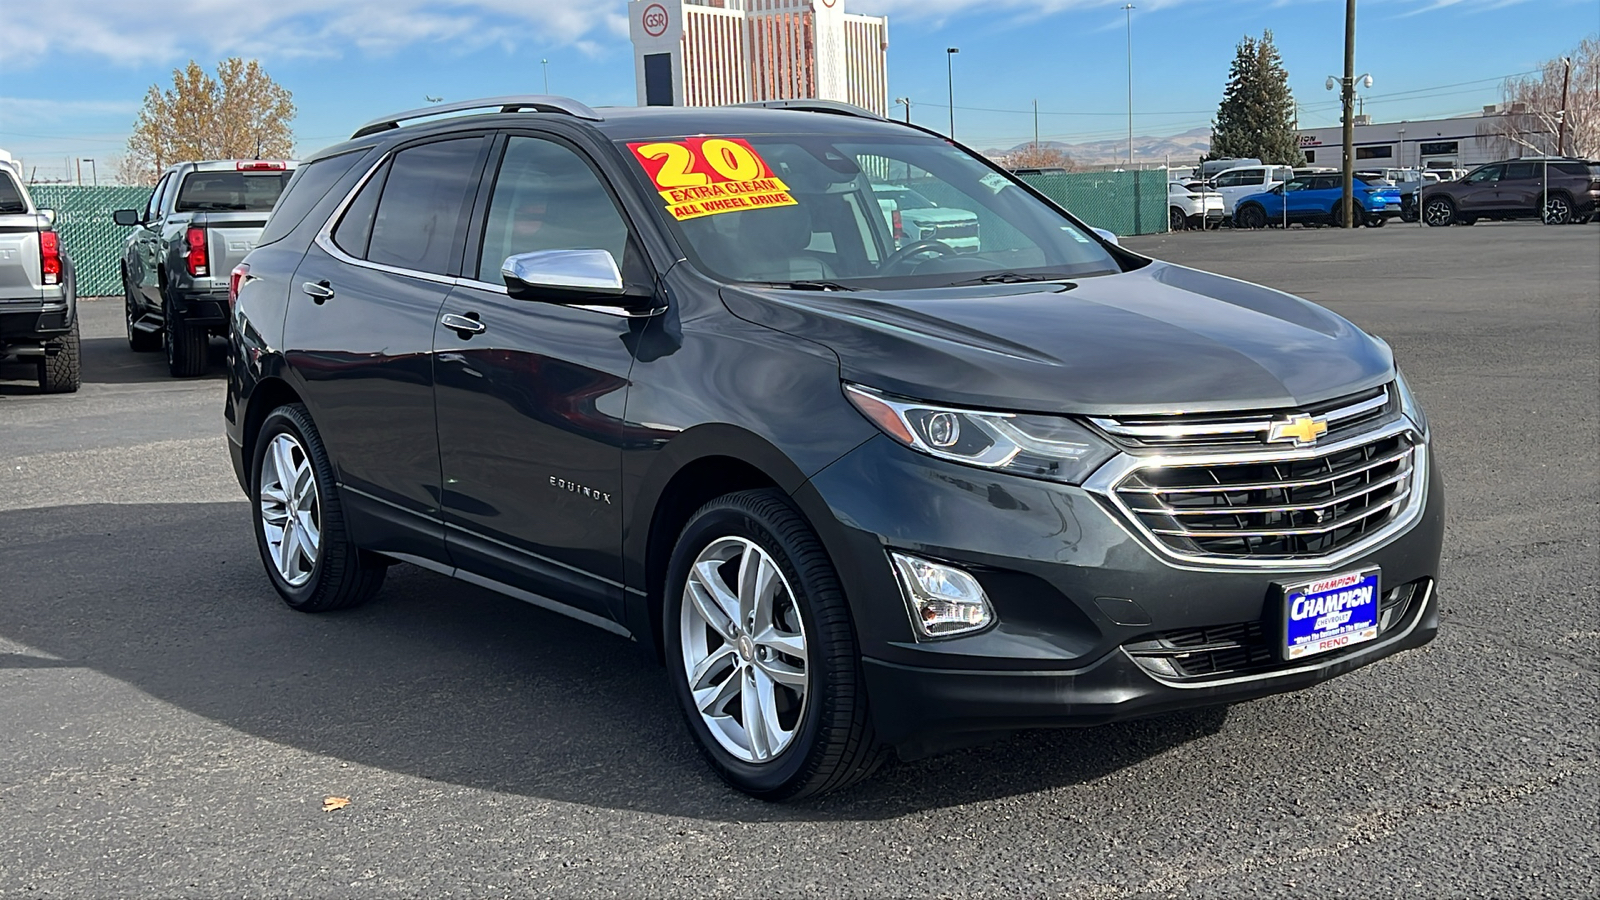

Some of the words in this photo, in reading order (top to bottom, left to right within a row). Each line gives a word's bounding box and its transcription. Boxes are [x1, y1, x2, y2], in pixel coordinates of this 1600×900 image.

[645, 13, 665, 28] GSR
[637, 139, 764, 188] 20
[670, 186, 726, 202] EXTRA
[725, 179, 778, 195] CLEAN
[674, 204, 703, 218] ALL
[701, 196, 749, 213] WHEEL
[751, 193, 791, 206] DRIVE
[549, 475, 611, 505] EQUINOX
[1312, 575, 1357, 592] CHAMPION
[1291, 586, 1373, 621] CHAMPION
[1317, 613, 1348, 627] CHEVROLET
[1319, 636, 1349, 650] RENO
